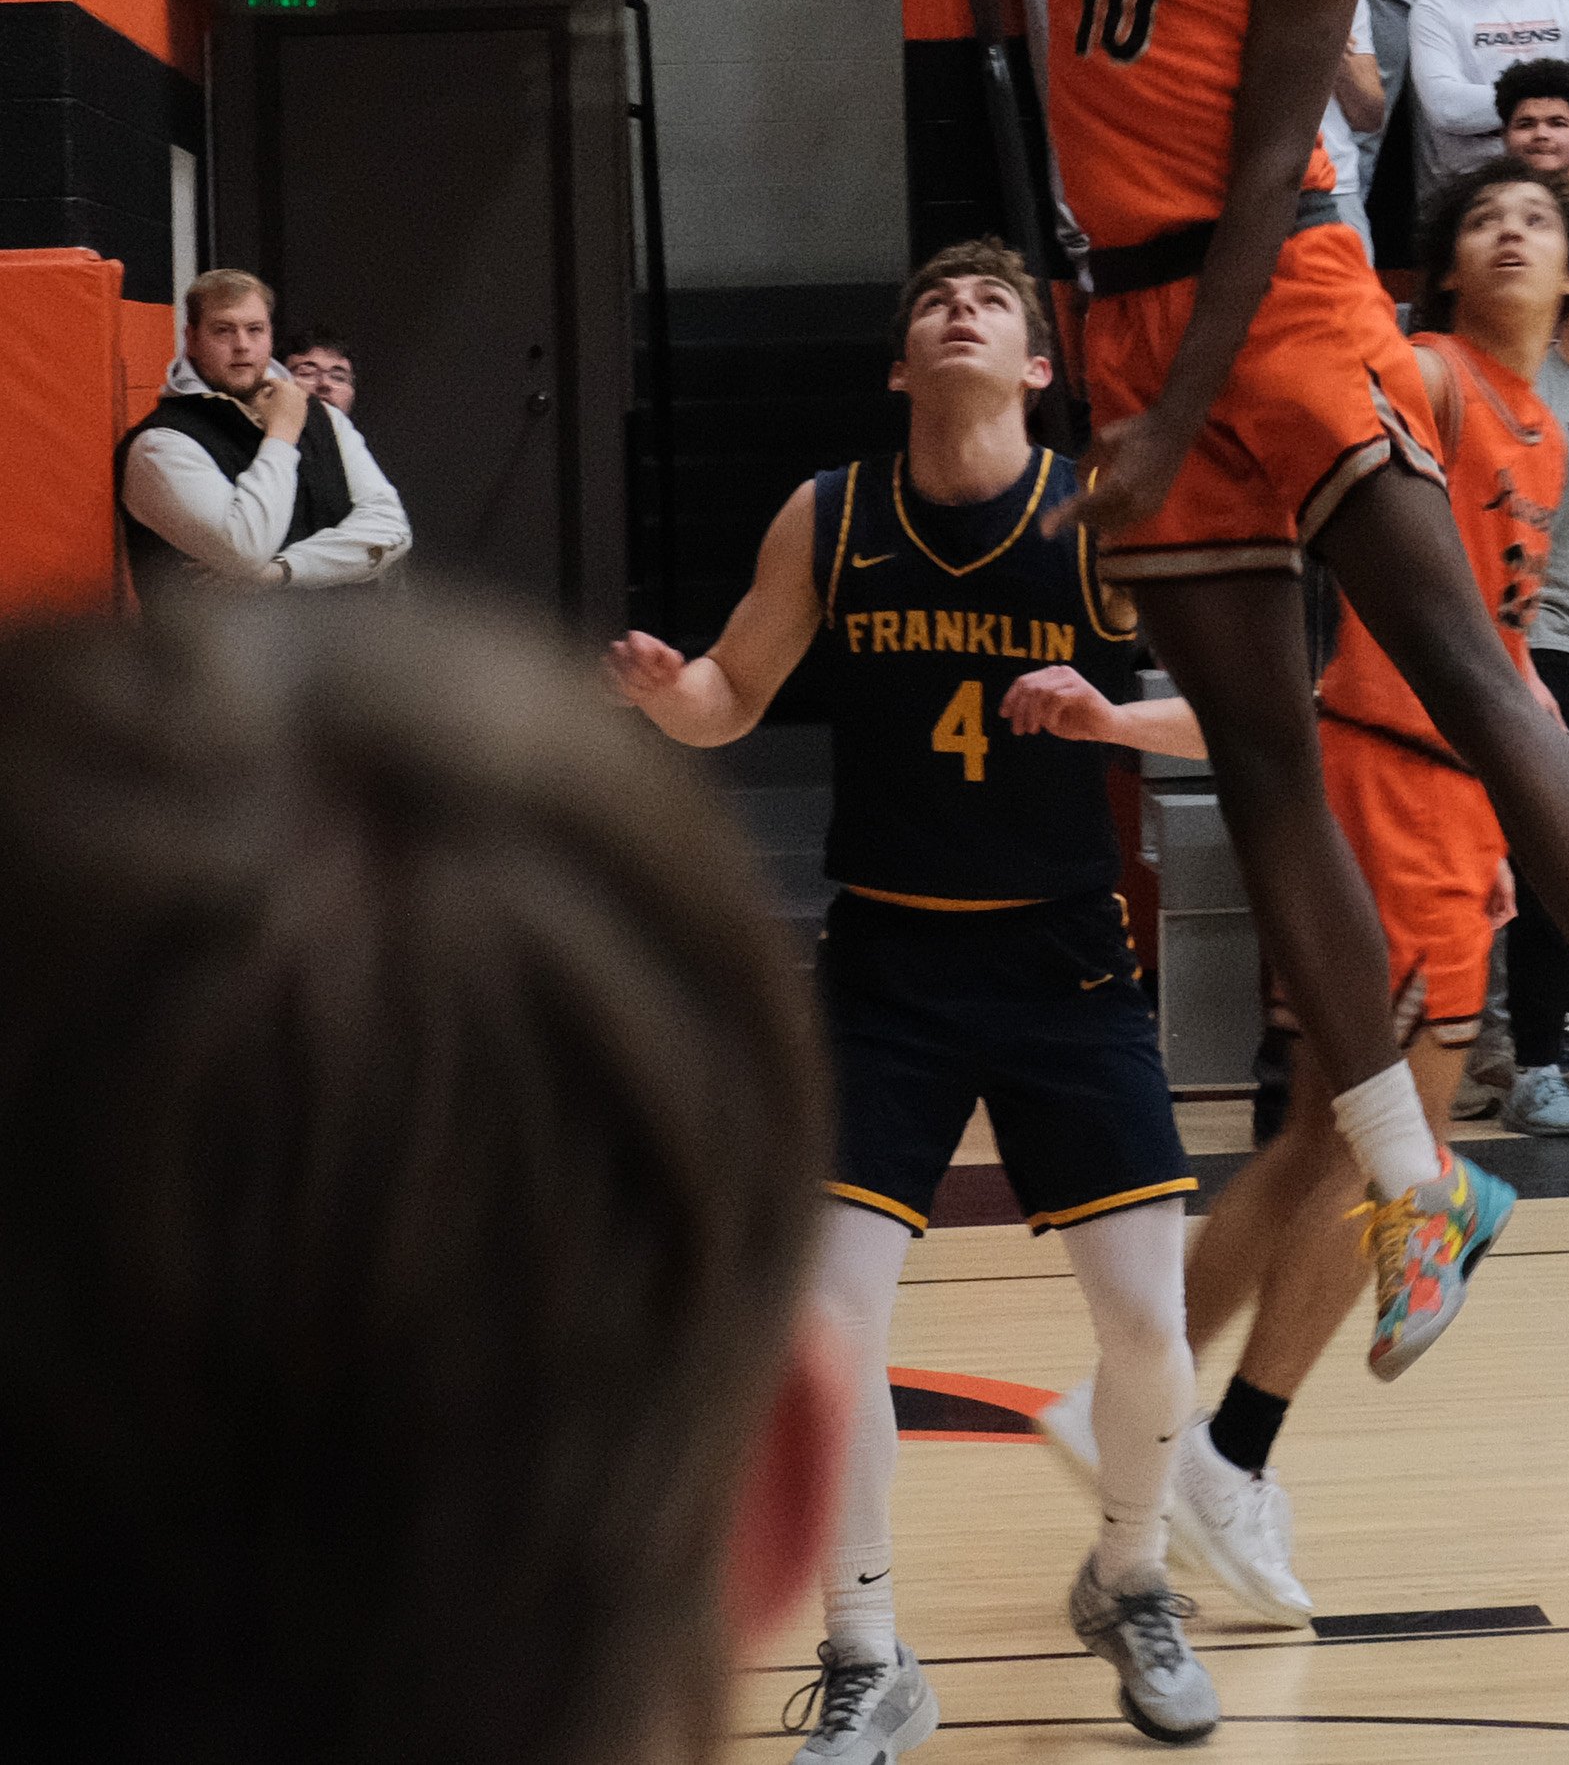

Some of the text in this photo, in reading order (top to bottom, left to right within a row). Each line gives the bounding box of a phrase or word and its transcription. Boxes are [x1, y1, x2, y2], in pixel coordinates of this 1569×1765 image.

[1474, 28, 1562, 48] RAVENS
[845, 609, 1076, 663] FRANKLIN
[930, 679, 990, 783] 4
